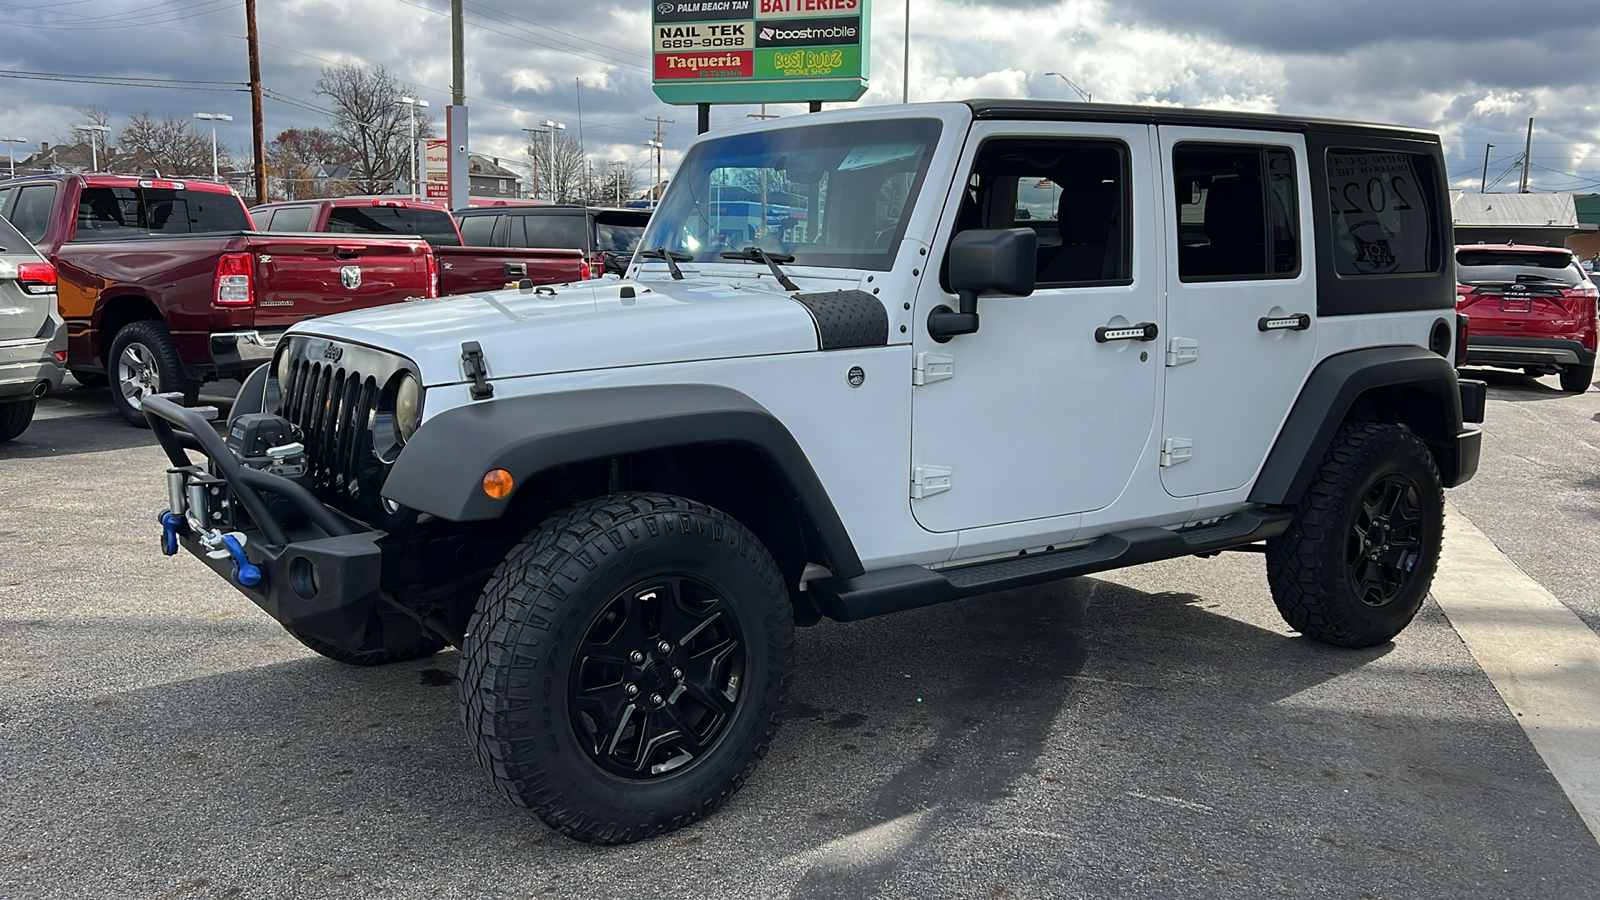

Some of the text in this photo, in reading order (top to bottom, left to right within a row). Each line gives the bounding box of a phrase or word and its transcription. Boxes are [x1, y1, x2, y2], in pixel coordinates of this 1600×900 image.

[677, 1, 749, 12] PALM BEACH TAN
[660, 25, 746, 38] NAIL TEK
[775, 26, 856, 39] boostmobile
[662, 37, 744, 48] 689-9088
[666, 53, 741, 70] Taquería
[784, 67, 831, 76] SMOKE SHOP
[323, 342, 343, 363] Jeep
